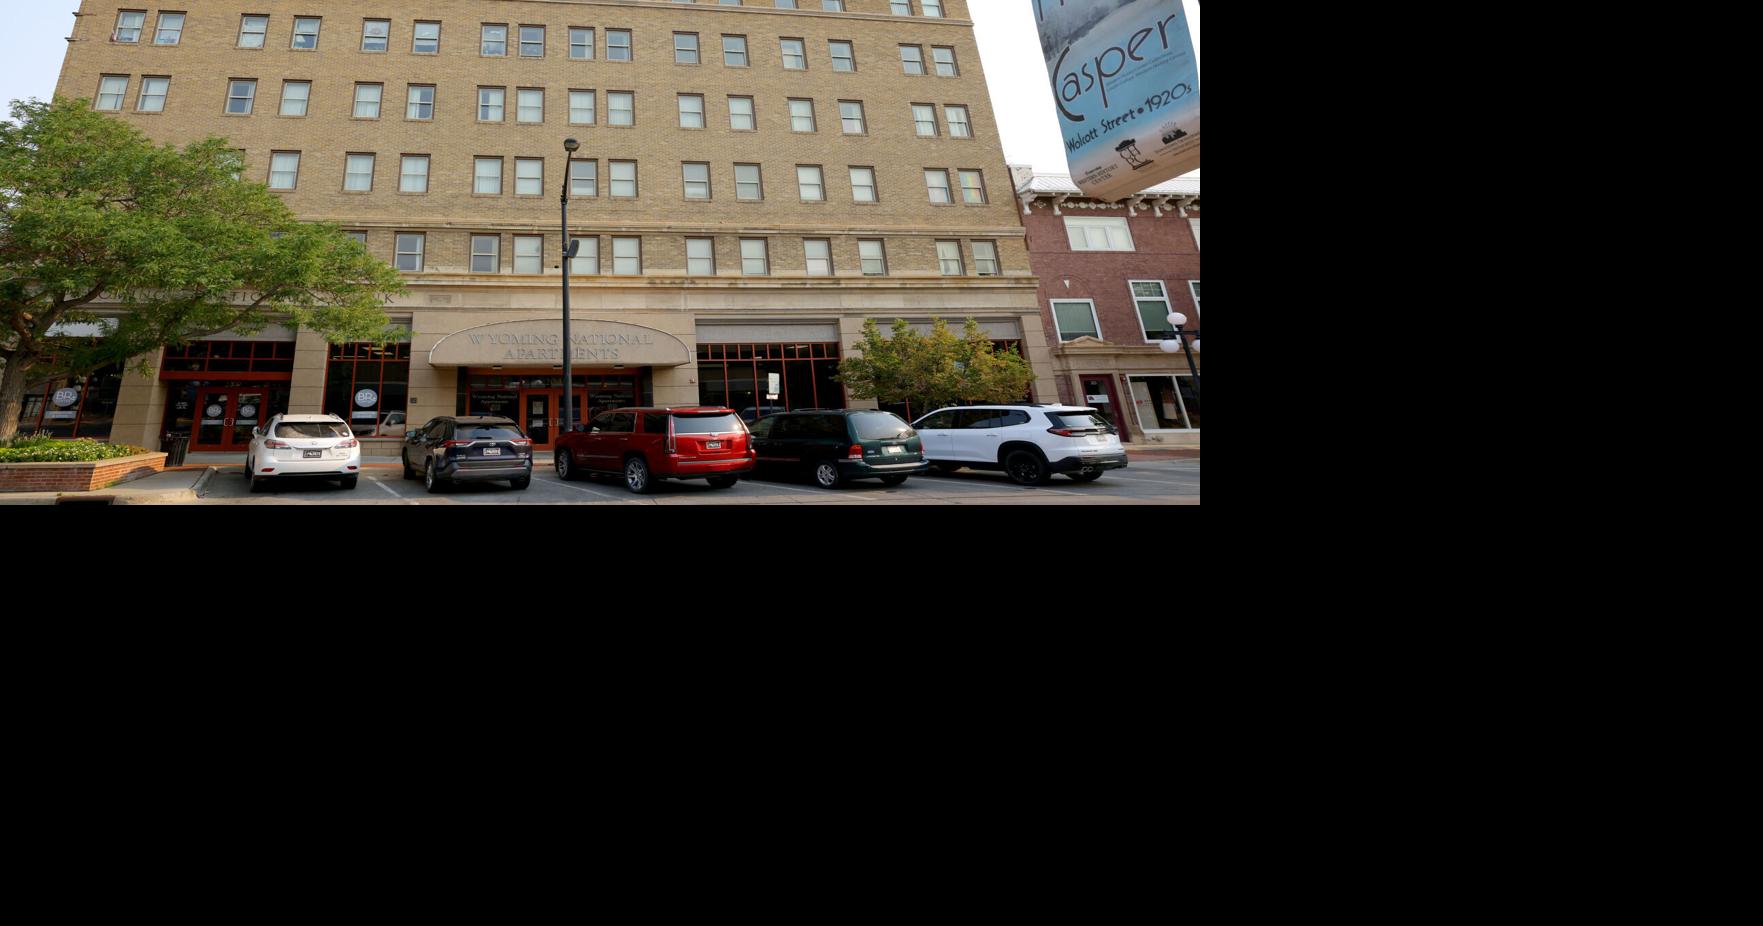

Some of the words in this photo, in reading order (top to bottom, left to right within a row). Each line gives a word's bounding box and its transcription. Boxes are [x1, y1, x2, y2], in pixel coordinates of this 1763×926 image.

[1052, 14, 1175, 122] Casper
[1067, 127, 1099, 153] Wolcott
[1101, 108, 1136, 134] Street
[1145, 83, 1192, 112] 1920s
[468, 333, 559, 346] WYOMING
[569, 334, 654, 346] NATIONAL
[504, 348, 619, 360] APARTENTS
